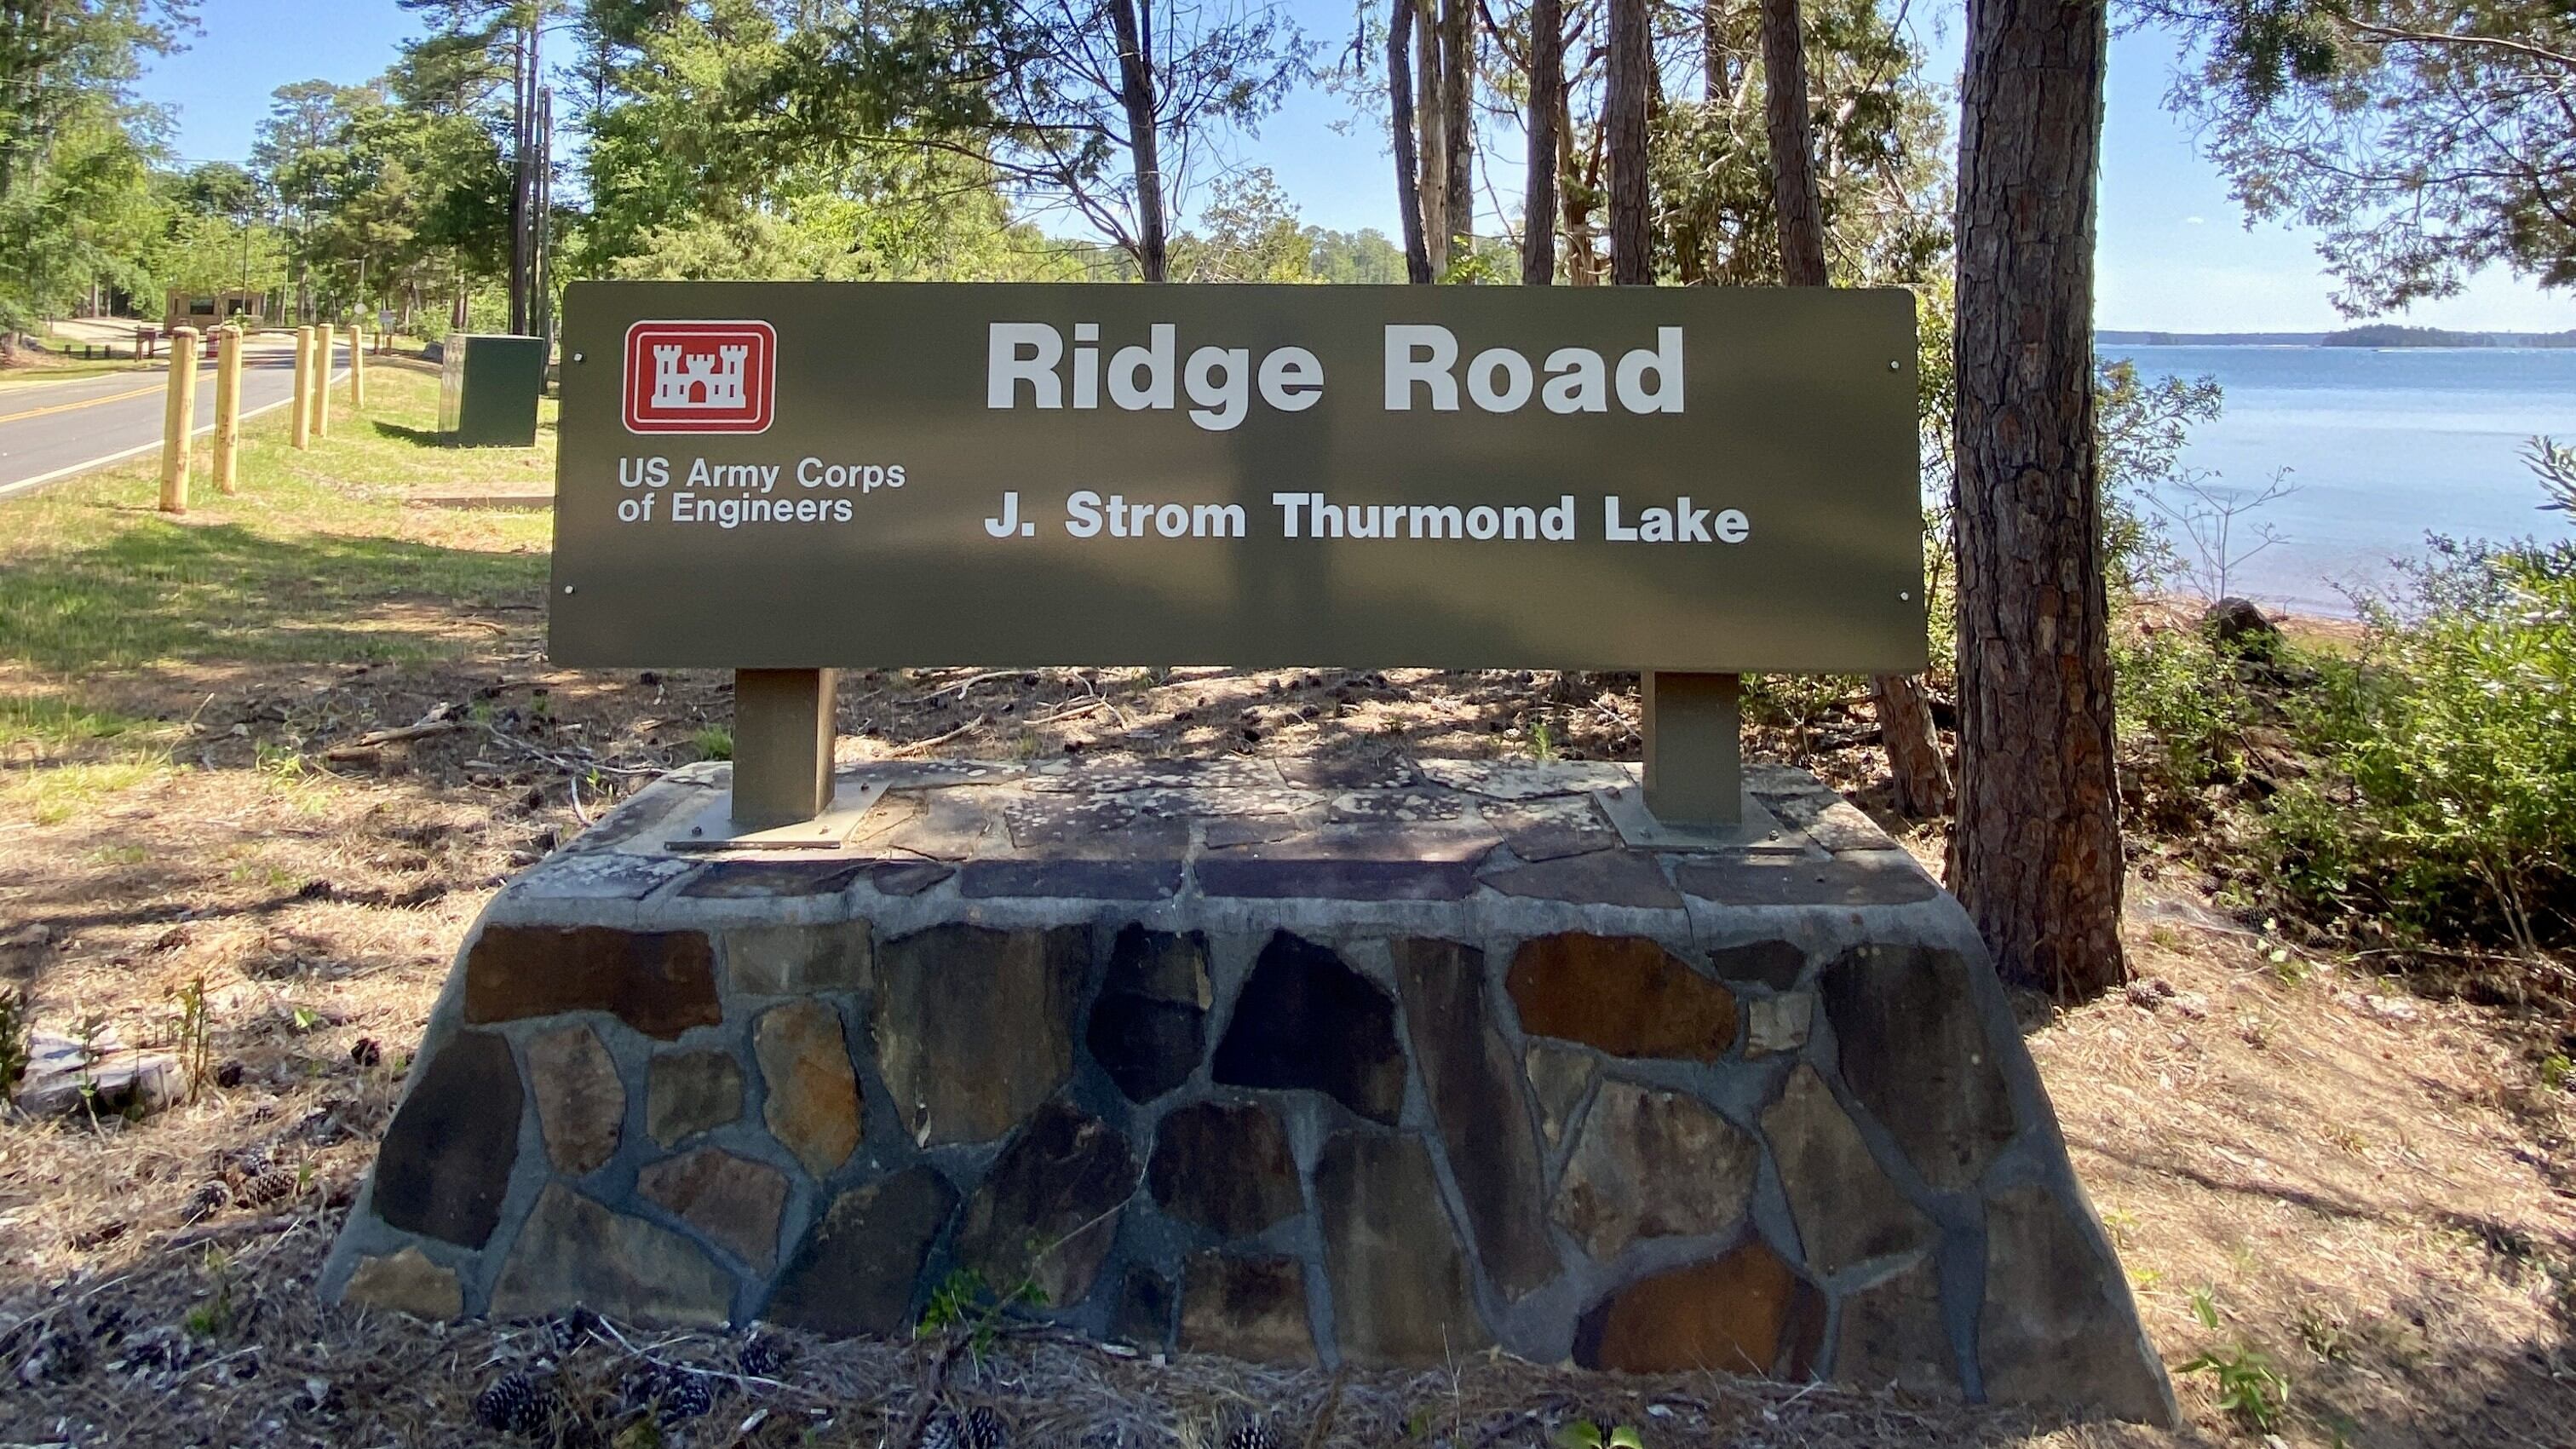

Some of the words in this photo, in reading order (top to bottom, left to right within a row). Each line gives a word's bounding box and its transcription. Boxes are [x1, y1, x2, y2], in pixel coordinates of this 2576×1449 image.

[986, 322, 1325, 432] Ridge
[1383, 325, 1685, 414] Road
[618, 457, 670, 488] US
[685, 457, 781, 493] Army
[796, 456, 906, 493] Corps
[617, 492, 656, 522] of
[671, 492, 854, 529] Engineers
[983, 492, 1036, 538] J.
[1064, 491, 1247, 539] Strom
[1271, 492, 1576, 543] Thurmond
[1603, 495, 1751, 544] Lake
